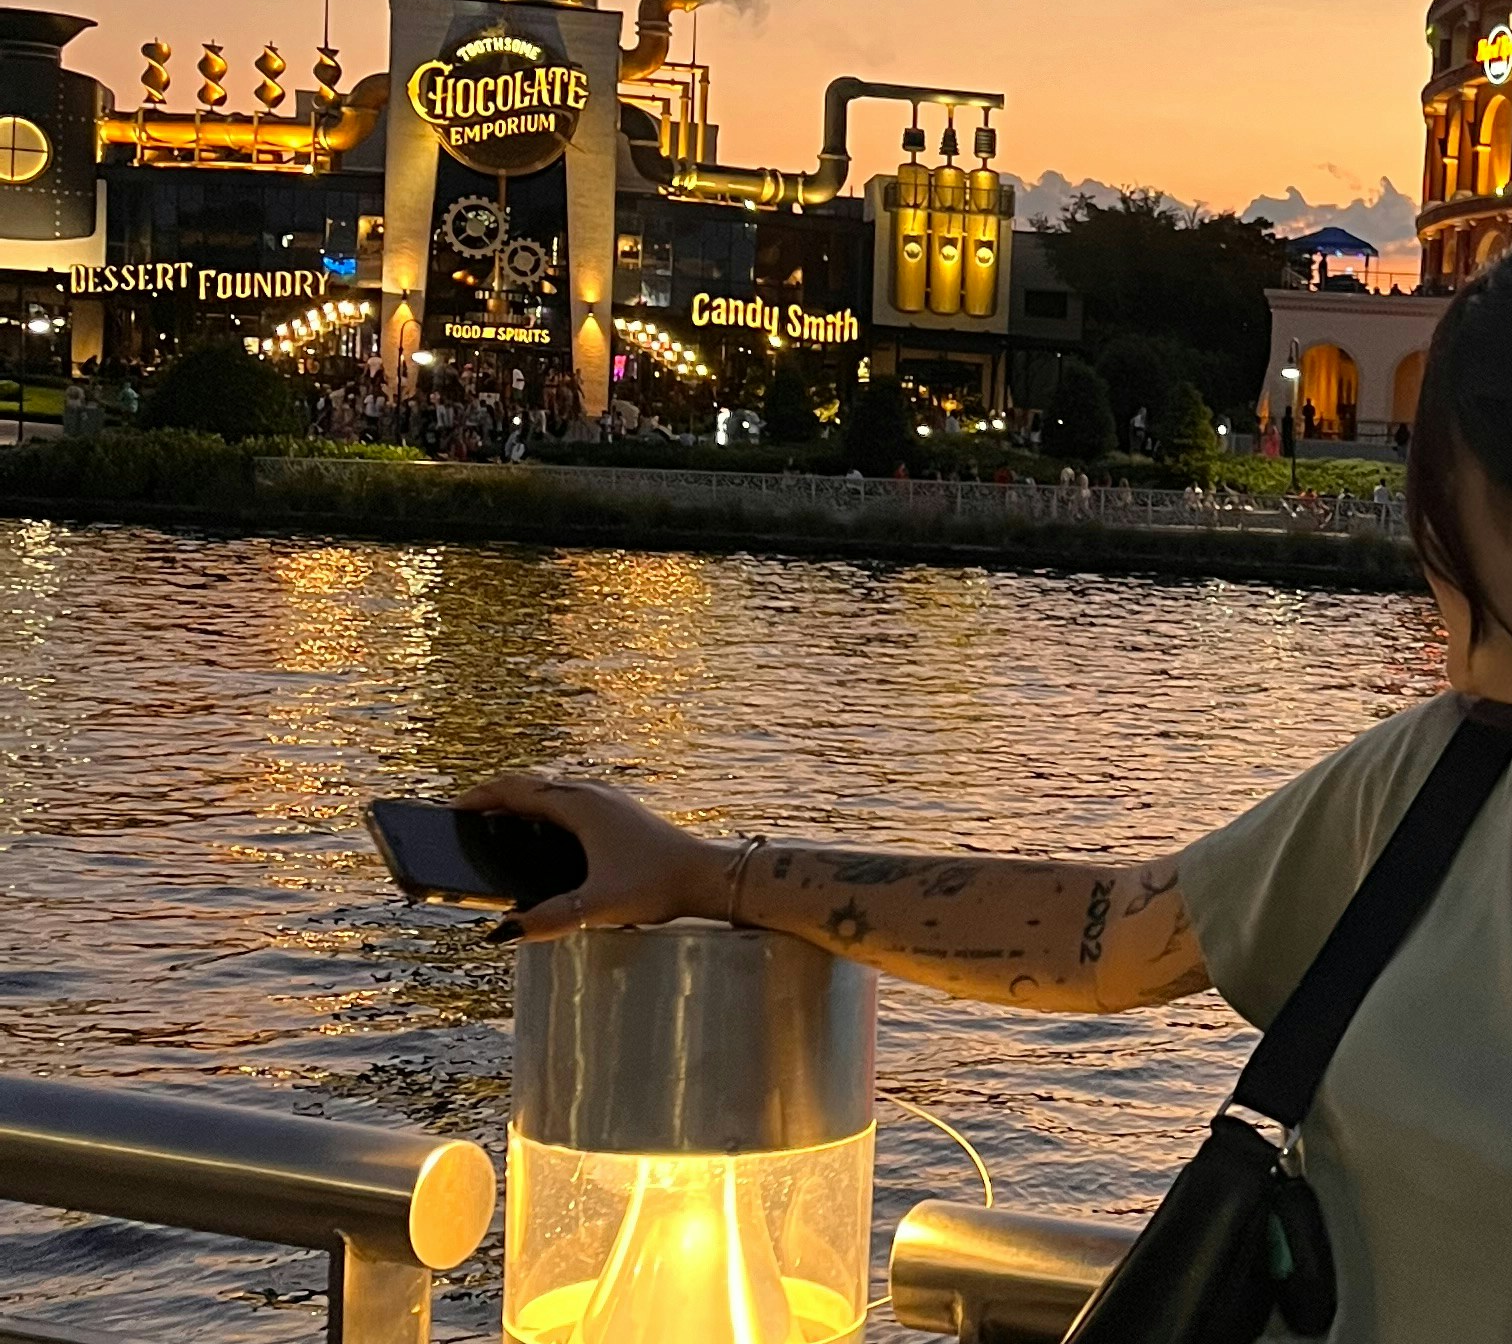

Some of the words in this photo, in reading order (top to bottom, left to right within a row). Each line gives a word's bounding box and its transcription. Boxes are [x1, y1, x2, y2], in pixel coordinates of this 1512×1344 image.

[456, 36, 542, 62] TOOTHSOME
[450, 113, 556, 146] EMPORIUM
[70, 262, 193, 294] DESSERT
[199, 269, 330, 301] FOUNDRY
[445, 323, 481, 339] FOOD
[496, 327, 551, 344] SPIRITS
[691, 292, 780, 337] Candy
[787, 304, 859, 343] Smith
[1080, 879, 1116, 964] 2002
